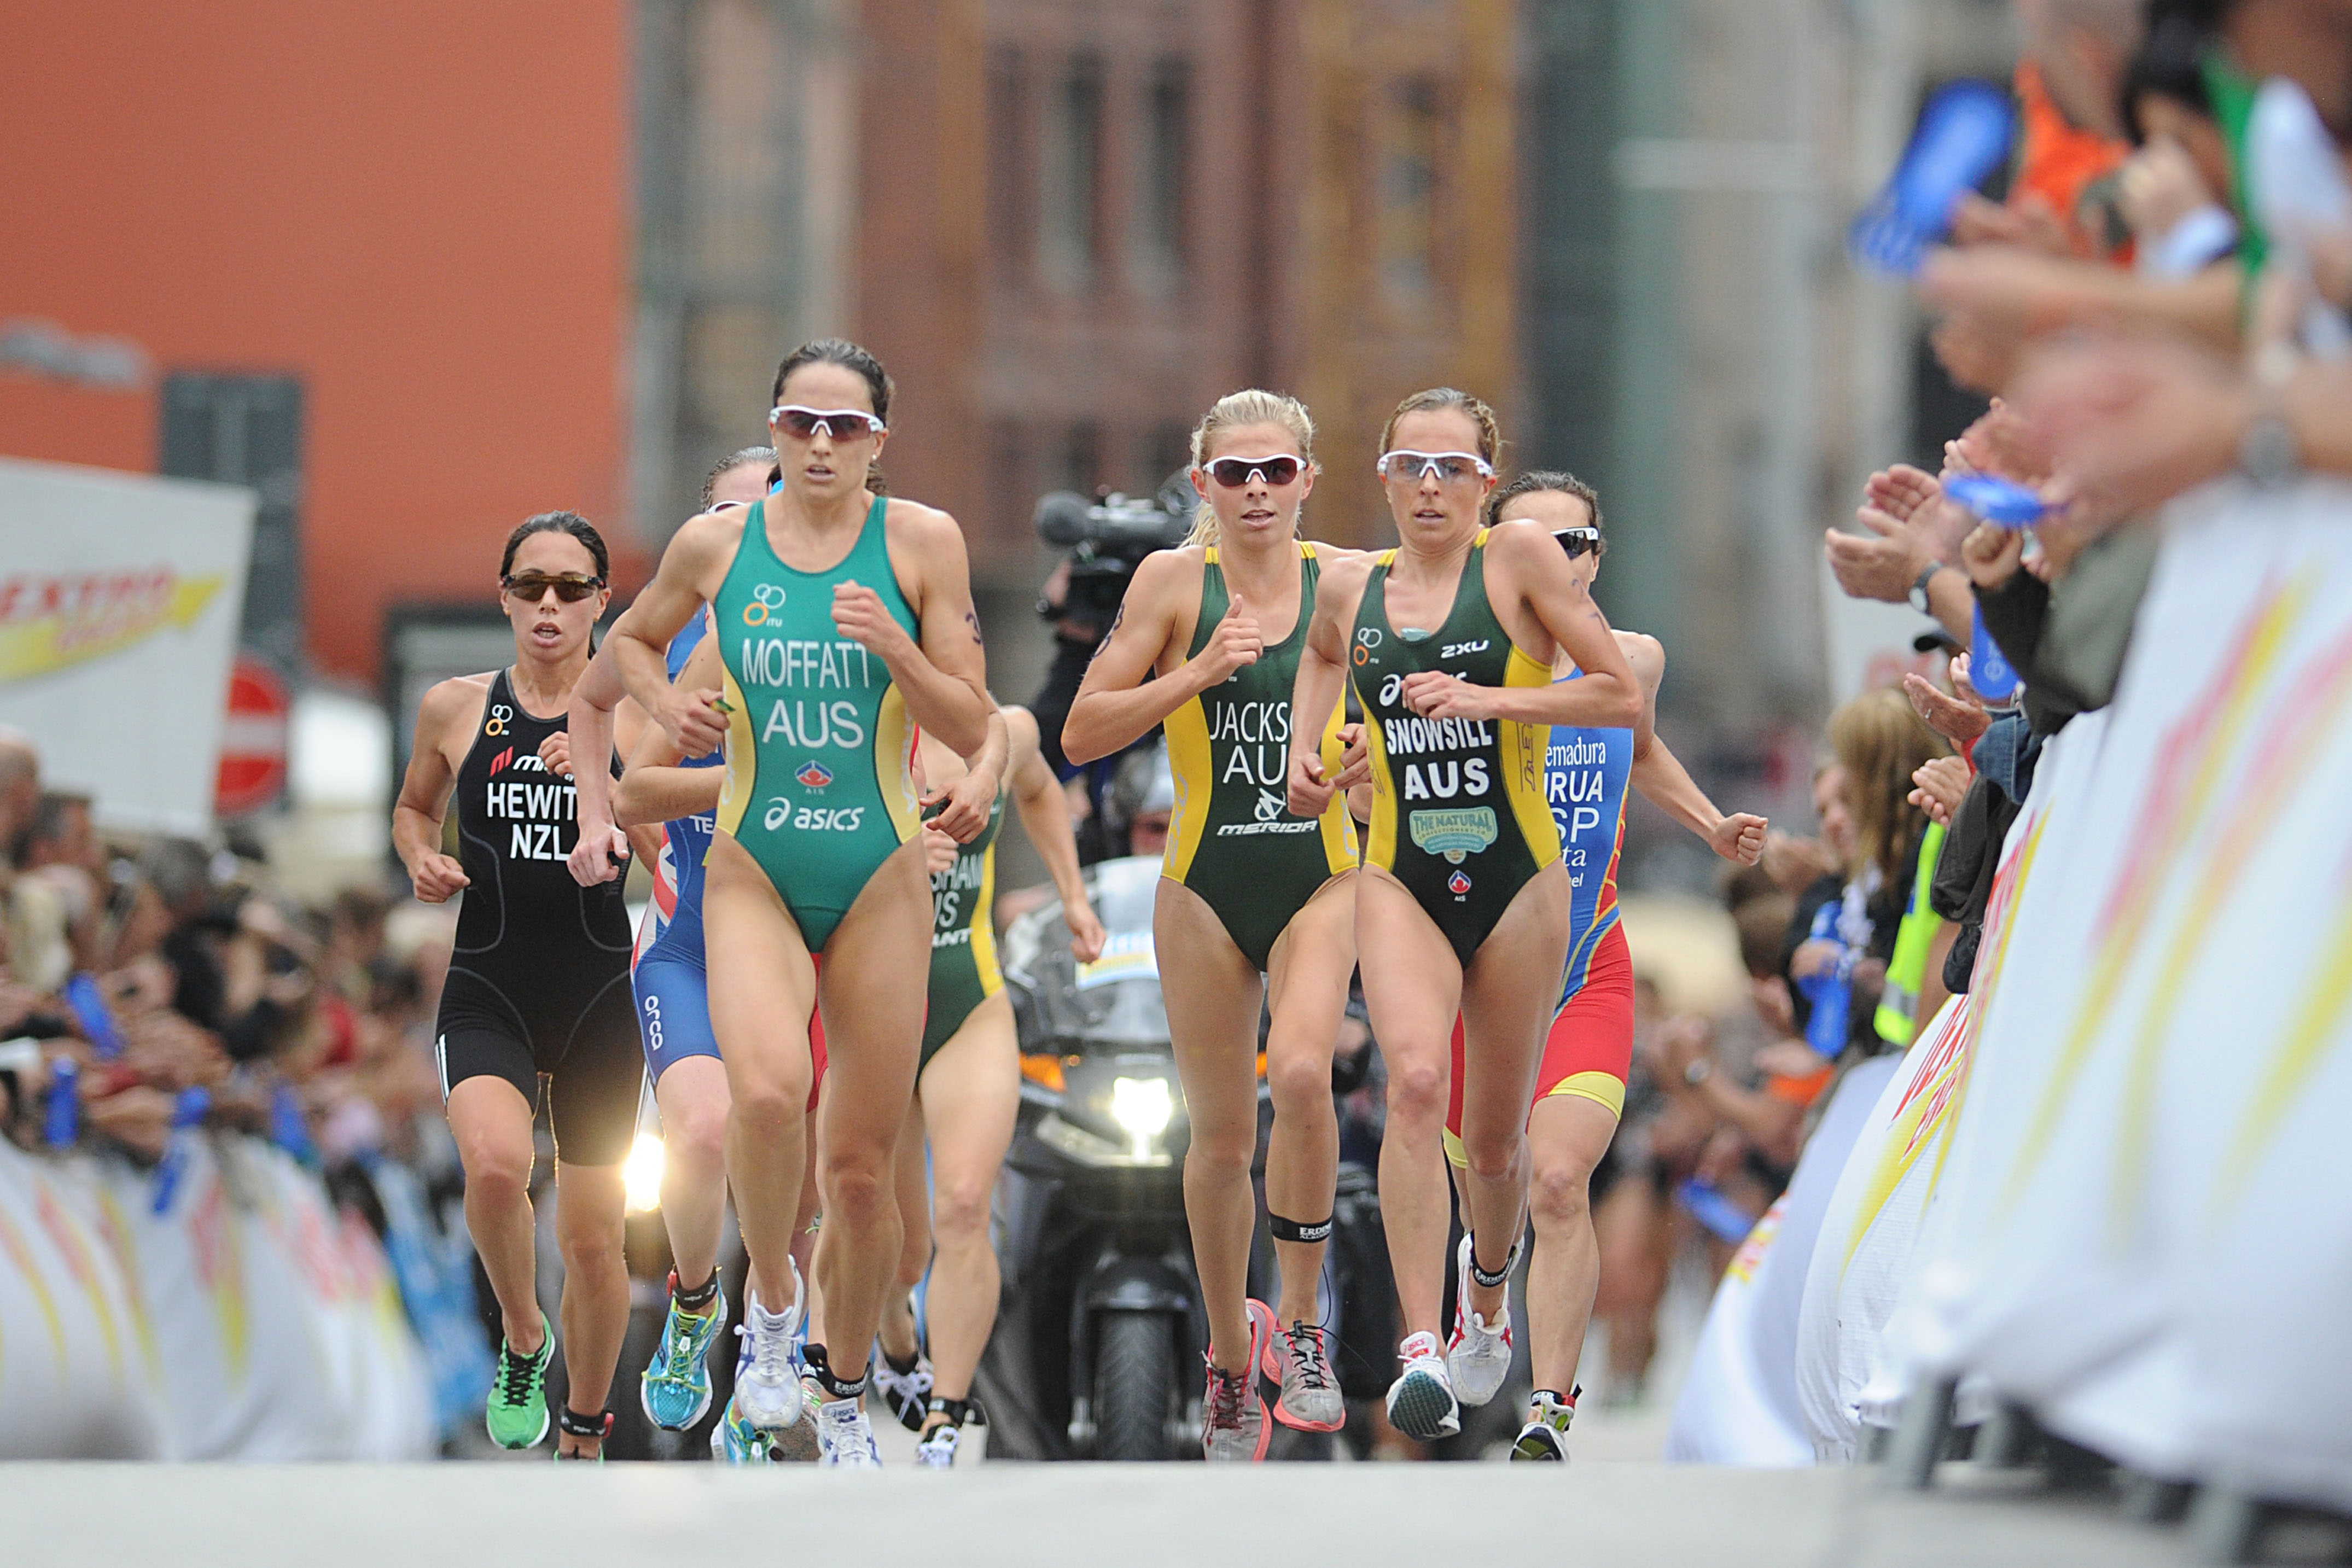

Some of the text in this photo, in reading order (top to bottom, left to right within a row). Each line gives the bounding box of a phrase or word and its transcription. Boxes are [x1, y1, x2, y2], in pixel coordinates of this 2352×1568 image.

[742, 638, 869, 689] MOFFATT
[1441, 639, 1491, 659] 2XU
[762, 700, 864, 749] AUS
[1209, 701, 1294, 743] JACKS
[1385, 716, 1493, 755] SNOWSILL
[1405, 757, 1490, 800] AUS
[794, 807, 865, 831] asics
[1216, 820, 1318, 836] MERIDA
[1413, 812, 1492, 835] THE NATURAL
[510, 824, 572, 861] NZL
[644, 995, 663, 1051] orca
